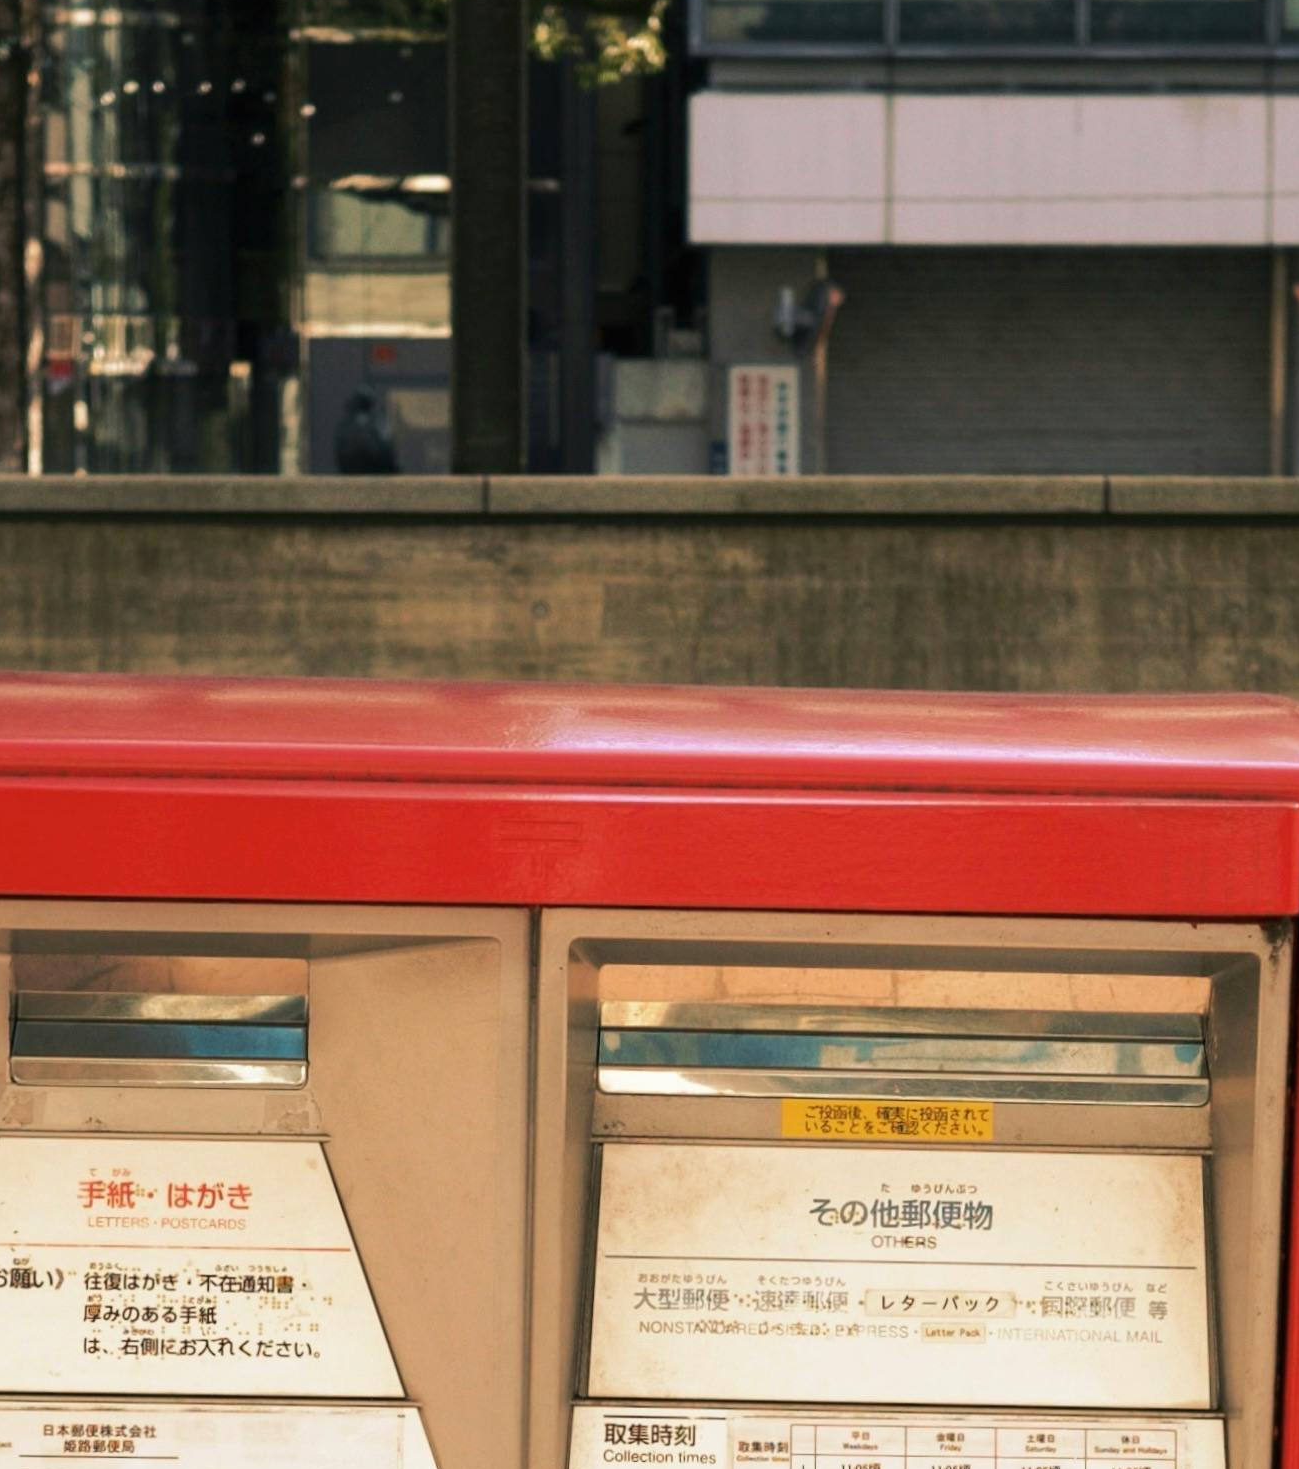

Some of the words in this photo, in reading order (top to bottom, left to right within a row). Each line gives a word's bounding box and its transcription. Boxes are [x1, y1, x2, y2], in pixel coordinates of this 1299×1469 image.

[805, 1105, 990, 1122] ご投函後、確実に投函されて
[805, 1120, 984, 1136] いることをご確認ください。
[809, 1198, 993, 1230] その他郵便物
[88, 1217, 149, 1228] LETTERS
[161, 1218, 246, 1230] POSTCARDS
[871, 1235, 937, 1248] OTHERS
[83, 1304, 217, 1324] 厚みのある手紙
[881, 1294, 1000, 1311] レターパック
[1148, 1300, 1168, 1319] 等
[925, 1327, 956, 1338] Letter
[960, 1328, 980, 1338] Pack
[997, 1327, 1121, 1343] INTERNATIONAL
[1126, 1330, 1163, 1343] MAIL
[83, 1337, 321, 1359] は、右側にお入れください。
[43, 1424, 157, 1439] 日本郵便株式会社
[604, 1423, 696, 1447] 取集時刻
[63, 1440, 135, 1454] 姫路郵便局
[738, 1441, 789, 1453] 取集時刻
[603, 1449, 674, 1464] Collection
[678, 1451, 716, 1464] times
